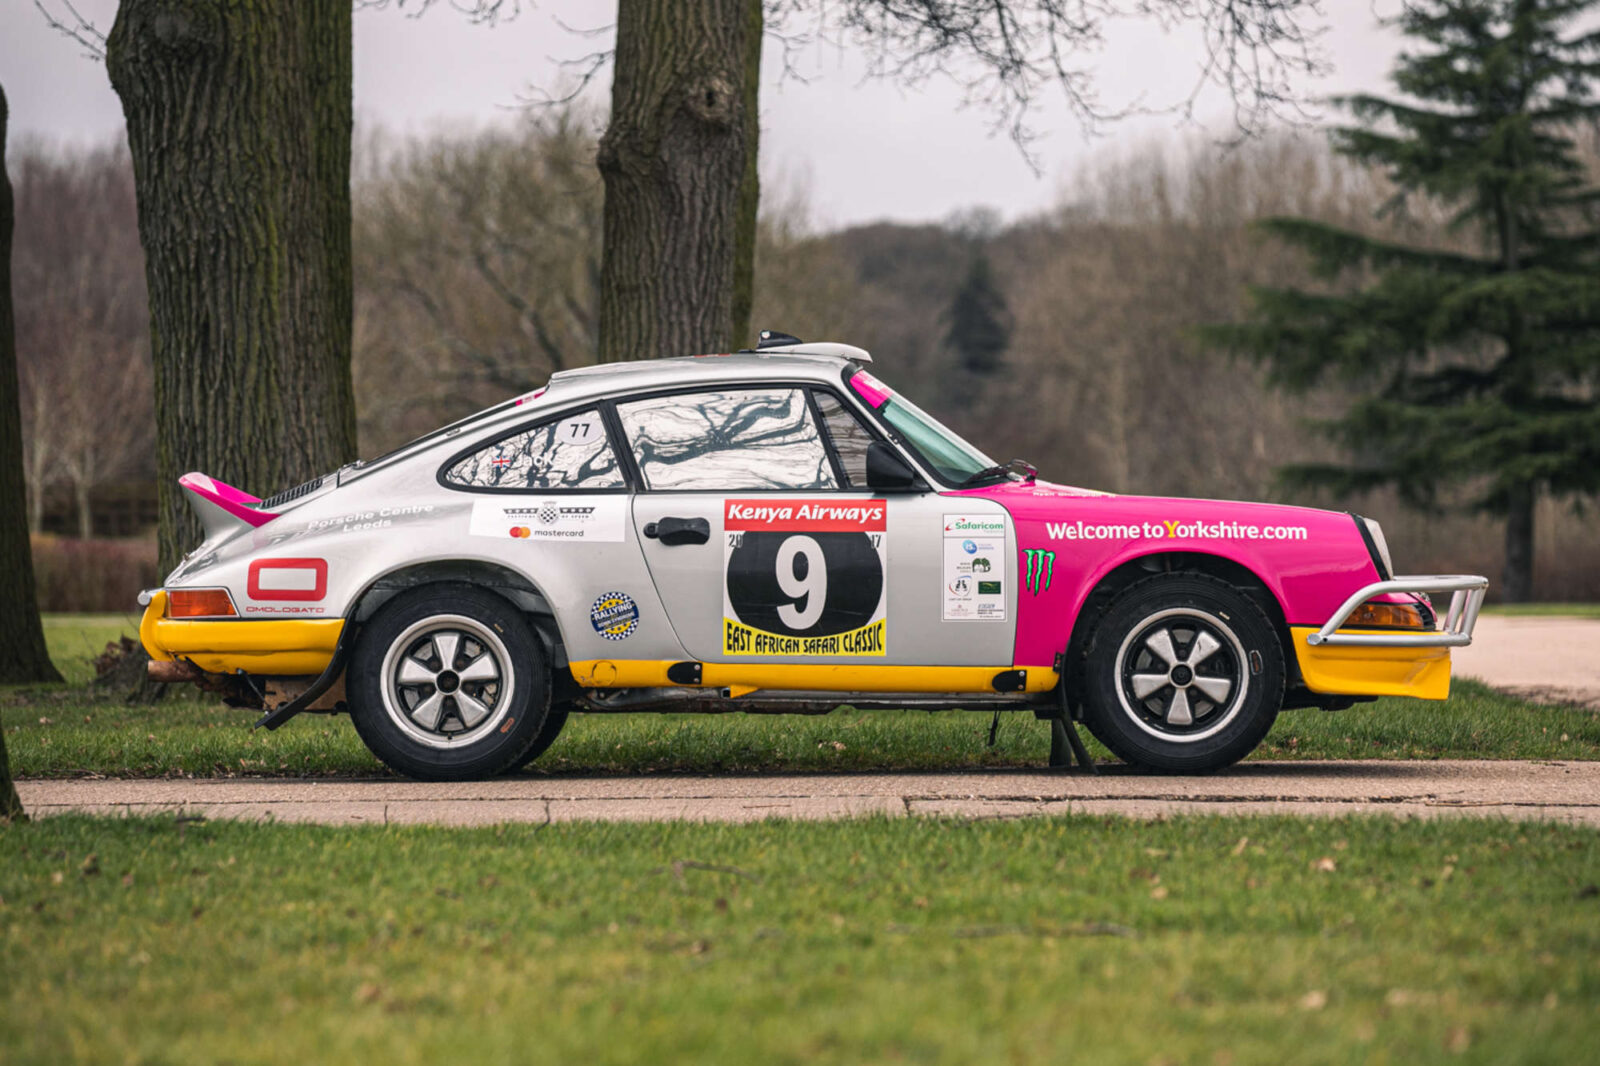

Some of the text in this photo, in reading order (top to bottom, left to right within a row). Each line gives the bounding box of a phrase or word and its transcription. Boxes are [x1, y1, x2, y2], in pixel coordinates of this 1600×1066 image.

[570, 423, 591, 438] 77
[308, 504, 434, 530] Porsche Centre
[727, 504, 884, 524] Kenya Airways
[342, 519, 392, 533] Leeds
[534, 529, 585, 537] mastercard
[955, 521, 1004, 530] Safaricom
[775, 534, 828, 630] 9
[245, 606, 325, 614] OMOLOGATO
[594, 602, 633, 621] RALLYING
[726, 621, 883, 655] EAST AFRICAN SAFARI CLASSIC
